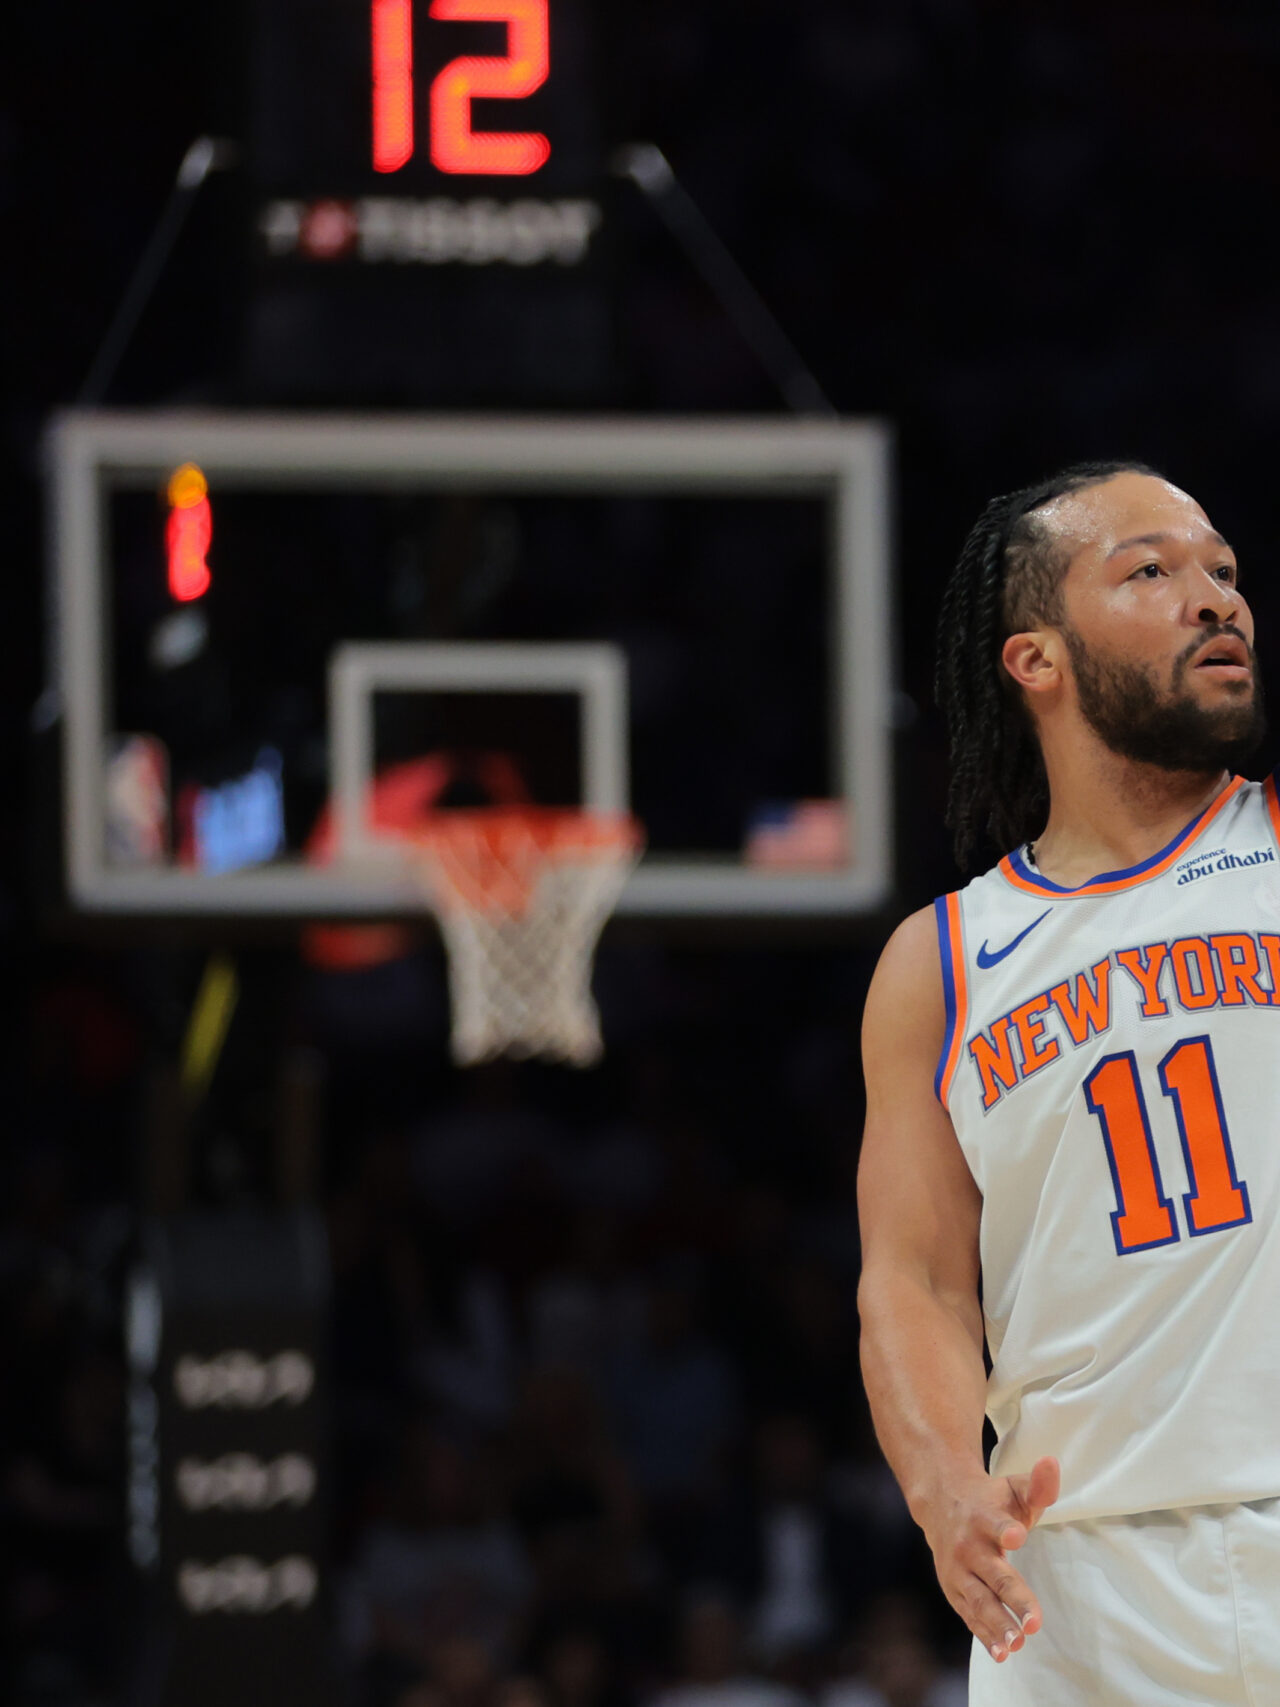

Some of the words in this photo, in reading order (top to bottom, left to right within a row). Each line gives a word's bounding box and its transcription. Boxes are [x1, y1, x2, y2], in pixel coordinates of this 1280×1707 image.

[372, 0, 551, 174] 12
[1176, 848, 1227, 872] experience
[1177, 863, 1214, 886] abu
[1216, 847, 1275, 871] dhabi
[968, 957, 1114, 1117] NEW
[1082, 1033, 1253, 1256] 11
